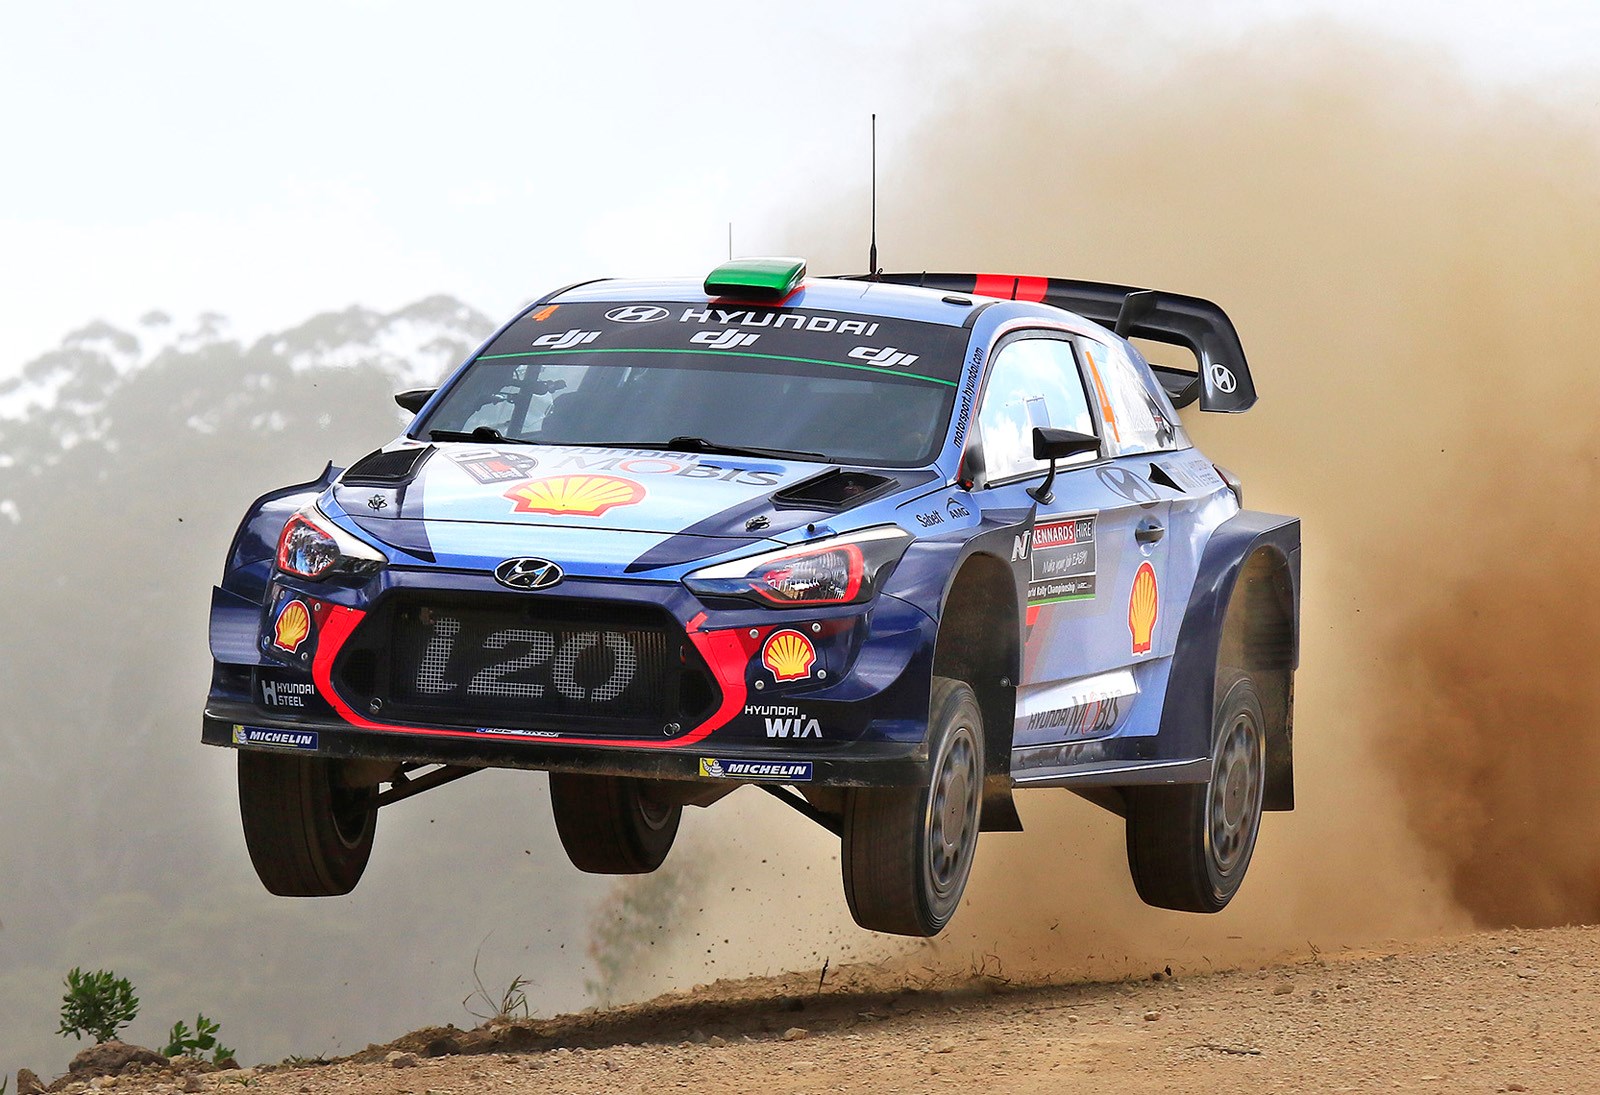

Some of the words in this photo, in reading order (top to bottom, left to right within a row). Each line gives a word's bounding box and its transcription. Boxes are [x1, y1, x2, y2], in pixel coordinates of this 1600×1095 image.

[532, 305, 560, 321] 4
[679, 308, 880, 336] HYUNDAI
[953, 347, 984, 449] motorsport.hyundai.com
[553, 456, 784, 486] MOBIS
[916, 510, 945, 528] Sabelt
[949, 507, 970, 520] AMG
[1033, 525, 1073, 545] KENNARDS
[1076, 522, 1092, 538] HIRE
[1027, 586, 1037, 598] orld
[1047, 581, 1075, 595] Championship
[276, 682, 315, 695] HYUNDAI
[278, 695, 304, 707] STEEL
[744, 705, 799, 716] HYUNDAI
[1027, 707, 1071, 731] HYUNDAI
[1063, 691, 1122, 736] MOBIS
[249, 731, 313, 745] MICHELIN
[727, 763, 807, 776] MICHELIN
